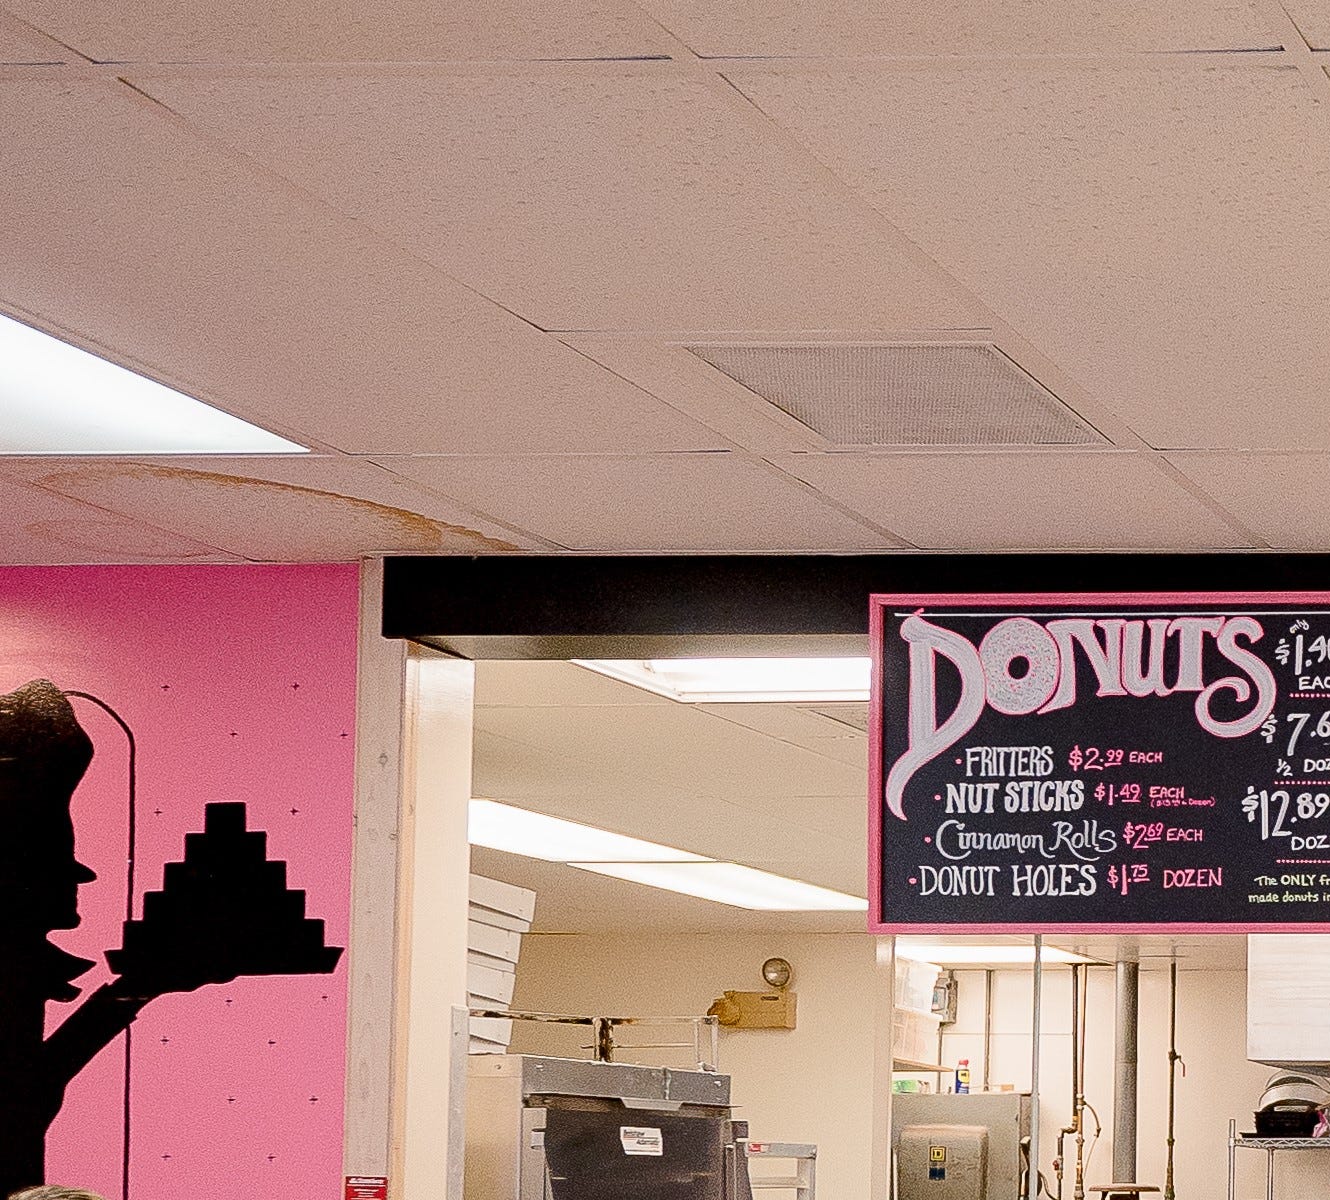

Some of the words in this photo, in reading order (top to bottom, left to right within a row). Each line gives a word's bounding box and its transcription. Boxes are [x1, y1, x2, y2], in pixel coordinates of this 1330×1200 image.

[886, 609, 1277, 821] DONUTS
[964, 746, 1054, 777] FRITTERS
[1068, 745, 1124, 771] $2.99
[1129, 751, 1163, 763] EACH
[944, 784, 1000, 814] NUT
[1004, 780, 1085, 812] STICKS
[1094, 782, 1141, 806] $1.49
[1149, 786, 1185, 799] EACH
[1241, 785, 1330, 840] $12.89
[936, 819, 1047, 860] Cinnamon
[1048, 818, 1118, 861] Rolls
[1166, 828, 1203, 842] EACH
[919, 865, 1000, 896] DONUT
[1012, 864, 1097, 897] HOLES
[1107, 864, 1151, 895] $1.75
[1163, 867, 1222, 888] DOZEN
[1247, 892, 1279, 903] made
[1282, 891, 1319, 903] donuts
[1253, 875, 1279, 887] The
[1280, 874, 1316, 887] ONLY
